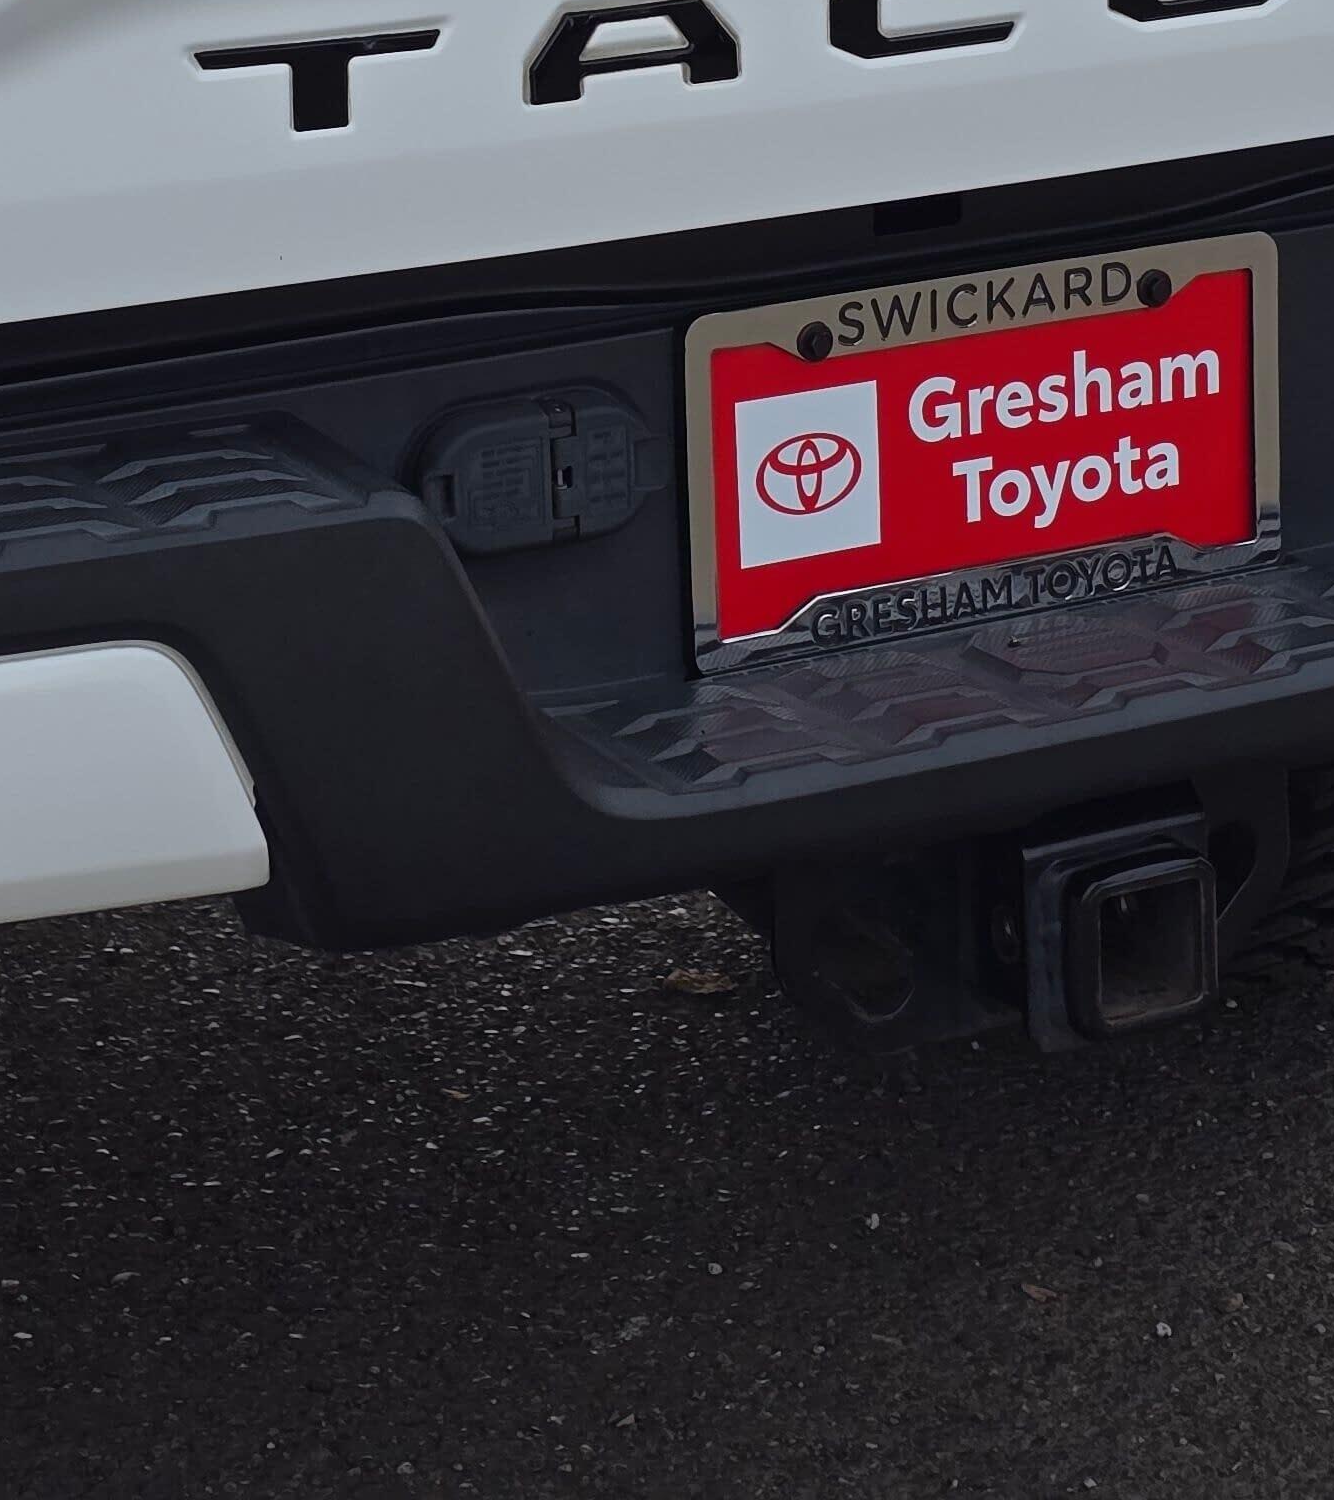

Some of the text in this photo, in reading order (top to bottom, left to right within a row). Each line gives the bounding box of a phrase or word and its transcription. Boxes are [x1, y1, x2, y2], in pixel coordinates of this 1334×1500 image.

[836, 261, 1132, 346] SWICKARD
[908, 349, 1221, 443] Gresham
[953, 435, 1181, 529] Toyota
[811, 544, 1180, 646] GRESHAM TOYOTA
